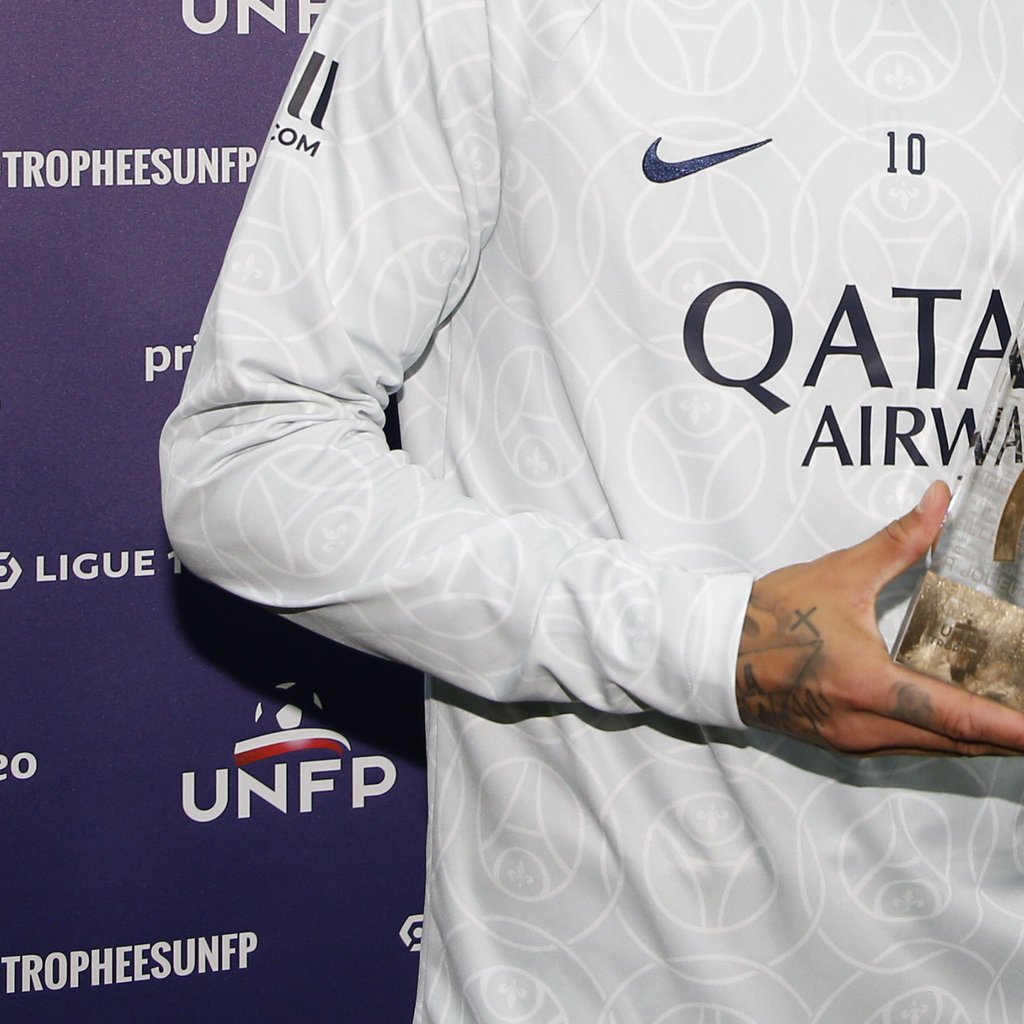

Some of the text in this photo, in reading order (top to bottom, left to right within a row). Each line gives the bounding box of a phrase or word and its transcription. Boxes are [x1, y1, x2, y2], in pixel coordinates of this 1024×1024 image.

[886, 131, 926, 175] 10
[36, 549, 155, 582] LIGUE
[182, 754, 397, 823] UNFP
